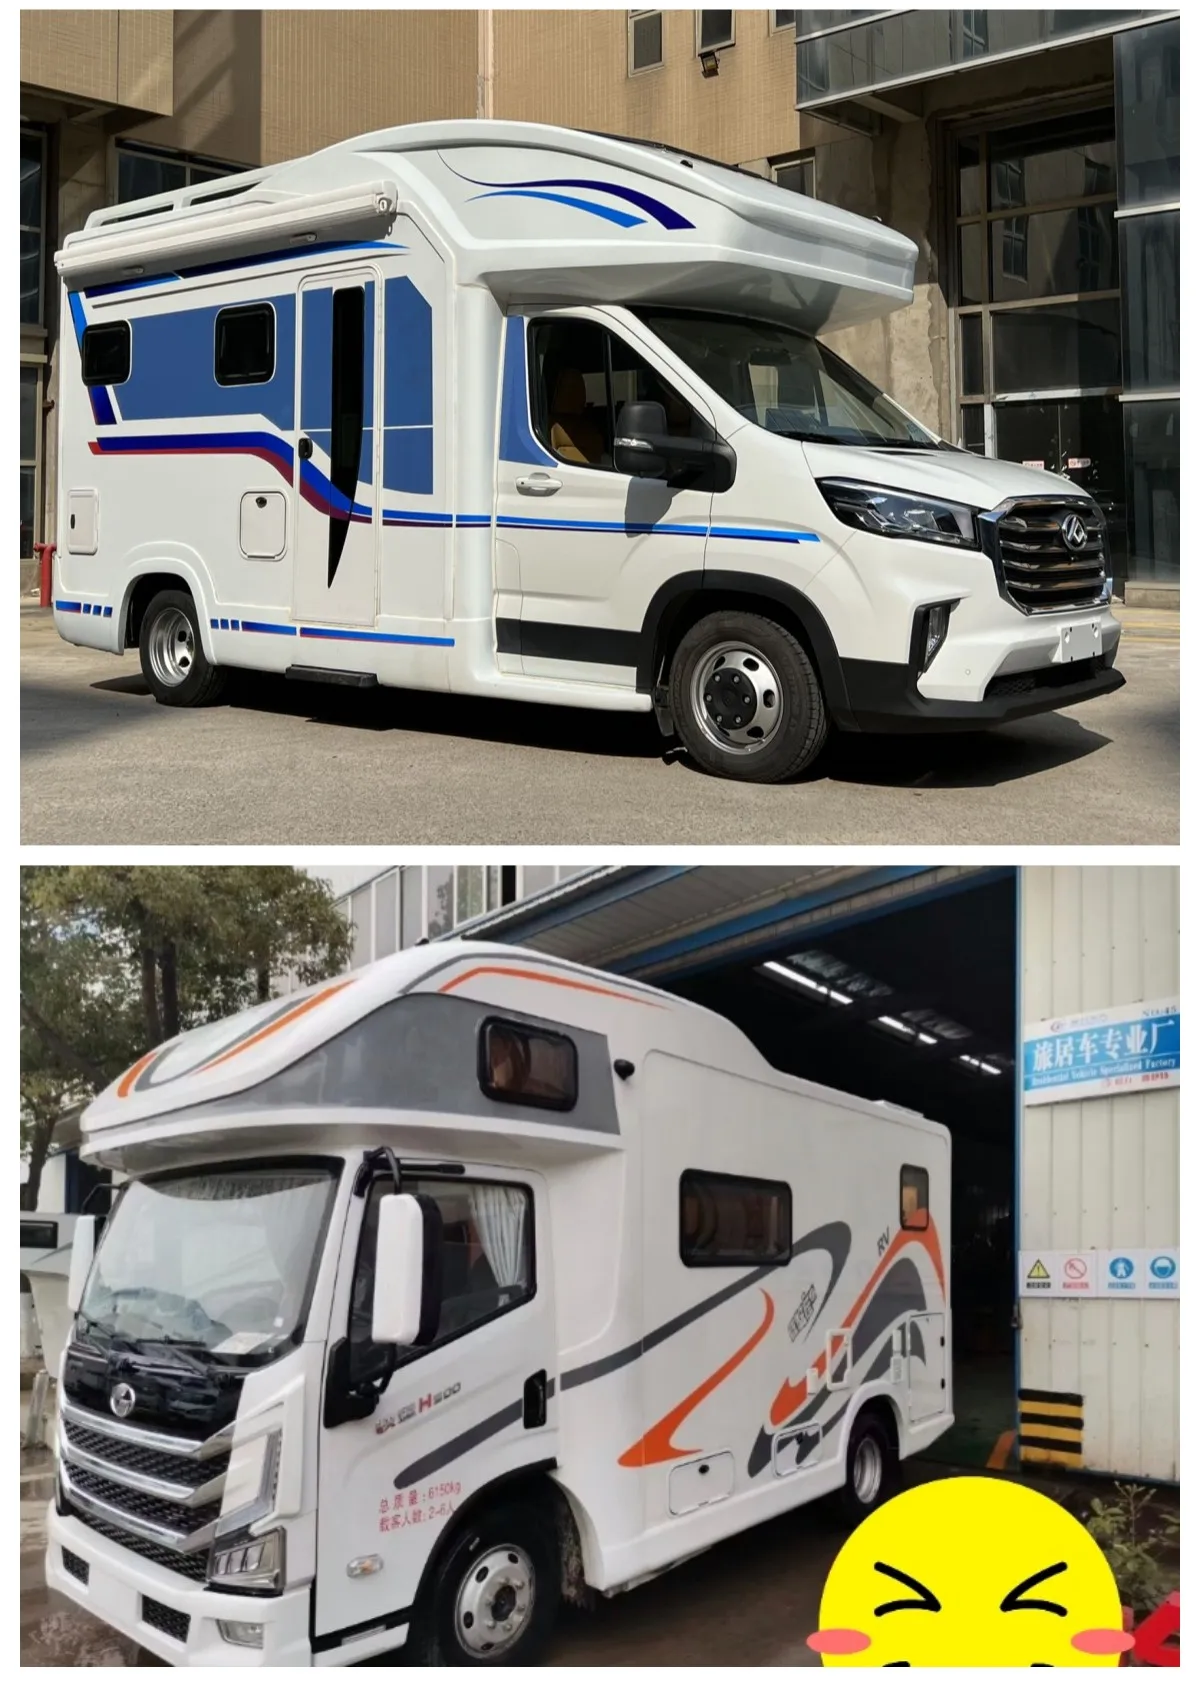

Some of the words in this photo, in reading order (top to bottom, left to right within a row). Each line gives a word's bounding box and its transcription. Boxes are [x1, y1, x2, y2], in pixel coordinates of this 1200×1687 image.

[1033, 1019, 1175, 1072] 旅居车专业厂
[1145, 1057, 1176, 1070] Factory
[877, 1225, 890, 1257] RV
